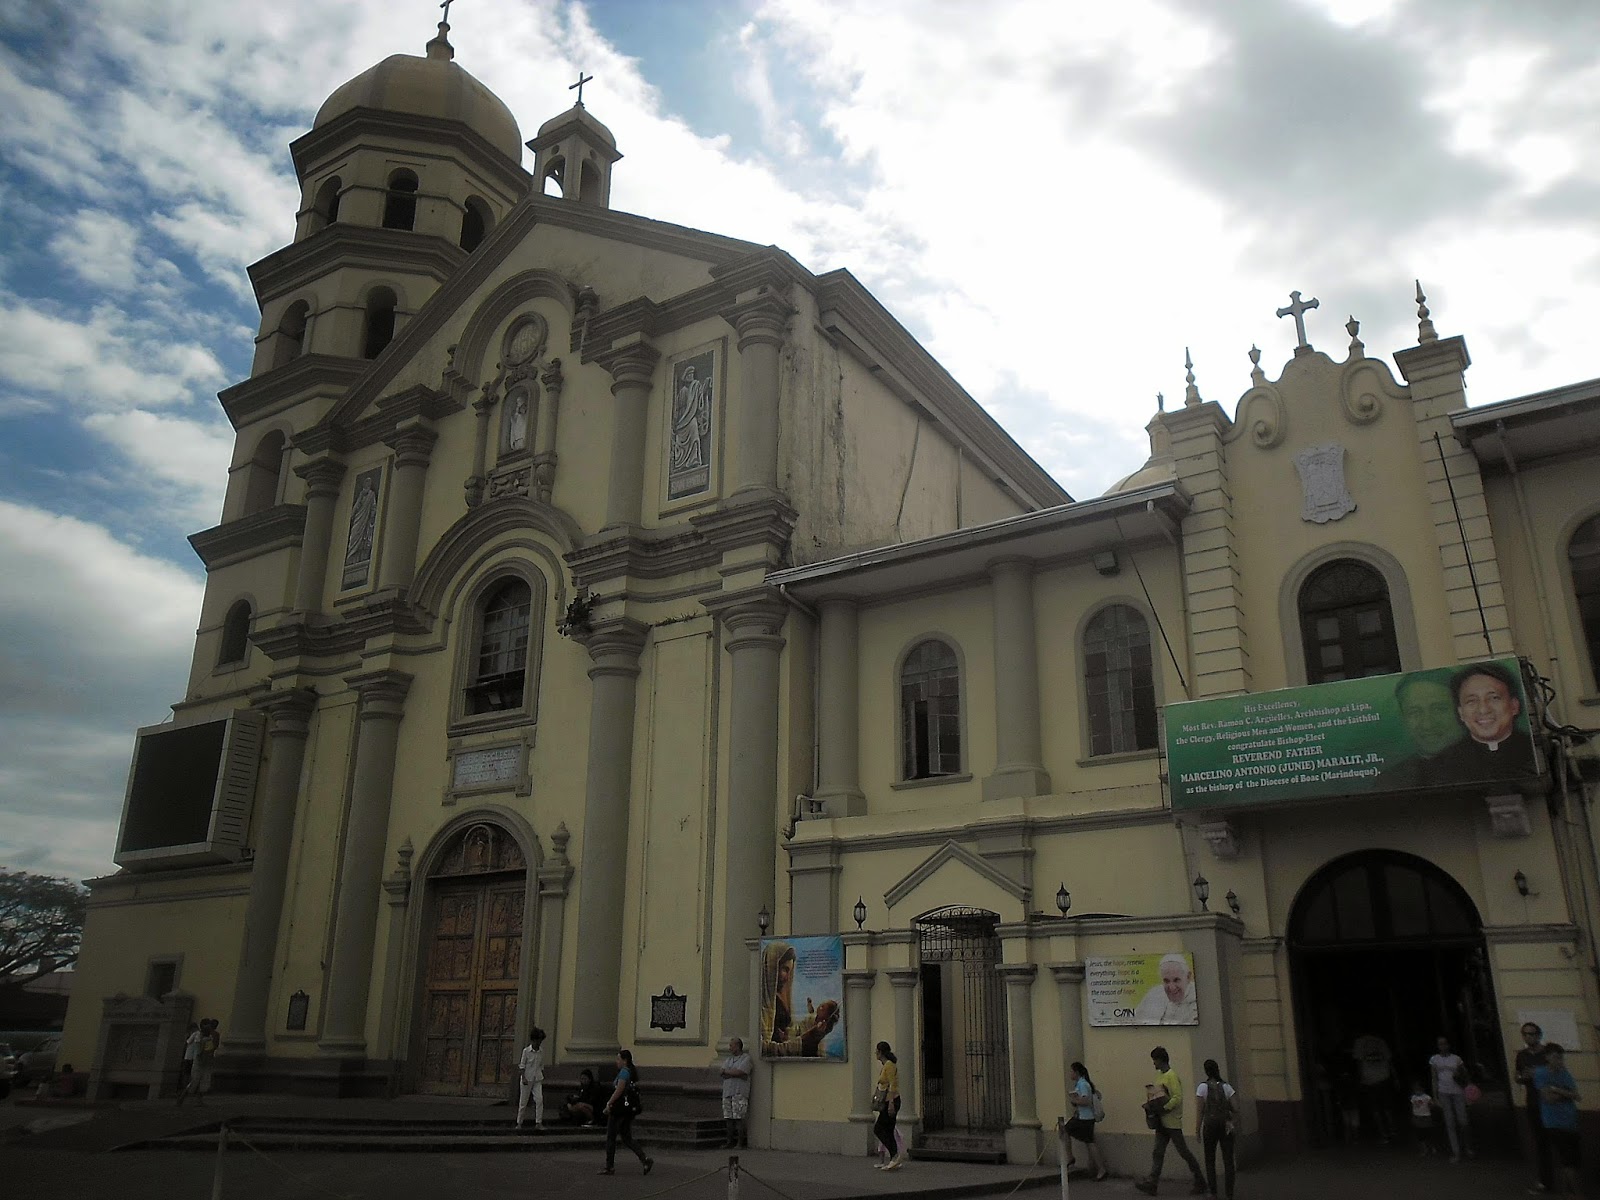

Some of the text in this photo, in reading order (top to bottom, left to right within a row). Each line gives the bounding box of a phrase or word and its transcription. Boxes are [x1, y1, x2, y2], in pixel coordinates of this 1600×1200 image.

[1182, 724, 1200, 732] Most
[1218, 719, 1243, 728] Ramon
[1295, 707, 1339, 719] Archbishop
[1342, 705, 1350, 713] of
[1351, 702, 1372, 713] Lipa,
[1244, 701, 1300, 713] His Excellency,
[1176, 713, 1379, 745] the Clergy, Religious Men and Women, and the faithful
[1227, 733, 1325, 751] congratulate Bishop-Elect
[1233, 746, 1323, 763] REVEREND FATHER
[1181, 769, 1232, 782] MARCELINO
[1234, 765, 1276, 778] ANTONIO
[1278, 761, 1316, 775] (JUNIE)
[1317, 755, 1364, 769] MARALIT,
[1195, 784, 1207, 793] the
[1209, 781, 1233, 793] bishop
[1236, 781, 1244, 789] of
[1246, 779, 1259, 788] the
[1261, 776, 1289, 786] Diocese
[1291, 774, 1299, 783] of
[1300, 773, 1319, 782] Boac
[1321, 767, 1380, 781] (Marinduque).
